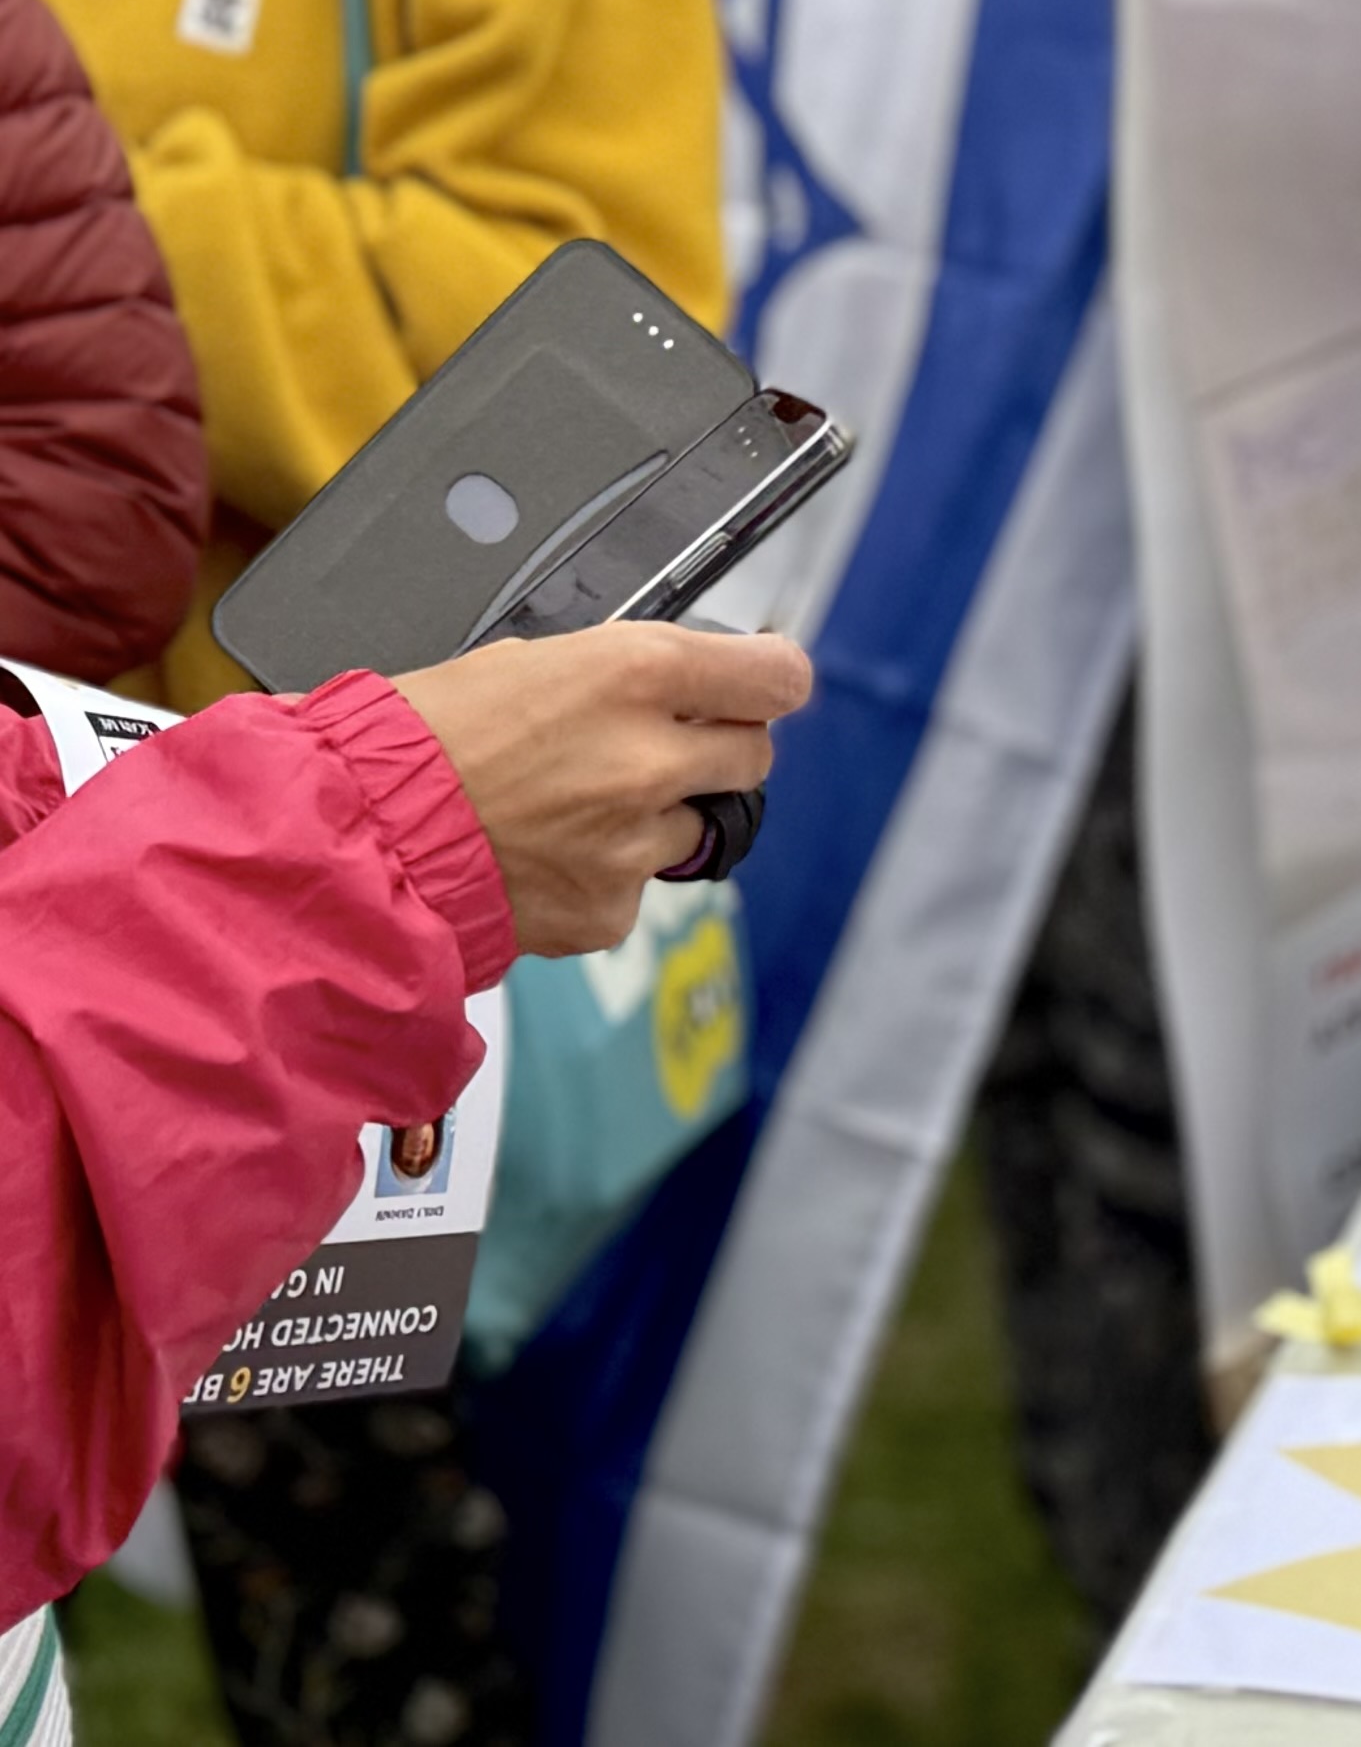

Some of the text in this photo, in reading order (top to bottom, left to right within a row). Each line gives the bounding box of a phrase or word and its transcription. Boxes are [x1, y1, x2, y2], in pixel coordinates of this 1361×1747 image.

[314, 1265, 345, 1296] IN
[271, 1304, 438, 1347] CONNECTED
[226, 1366, 251, 1403] 6
[252, 1362, 314, 1396] ARE
[316, 1354, 404, 1390] THERE
